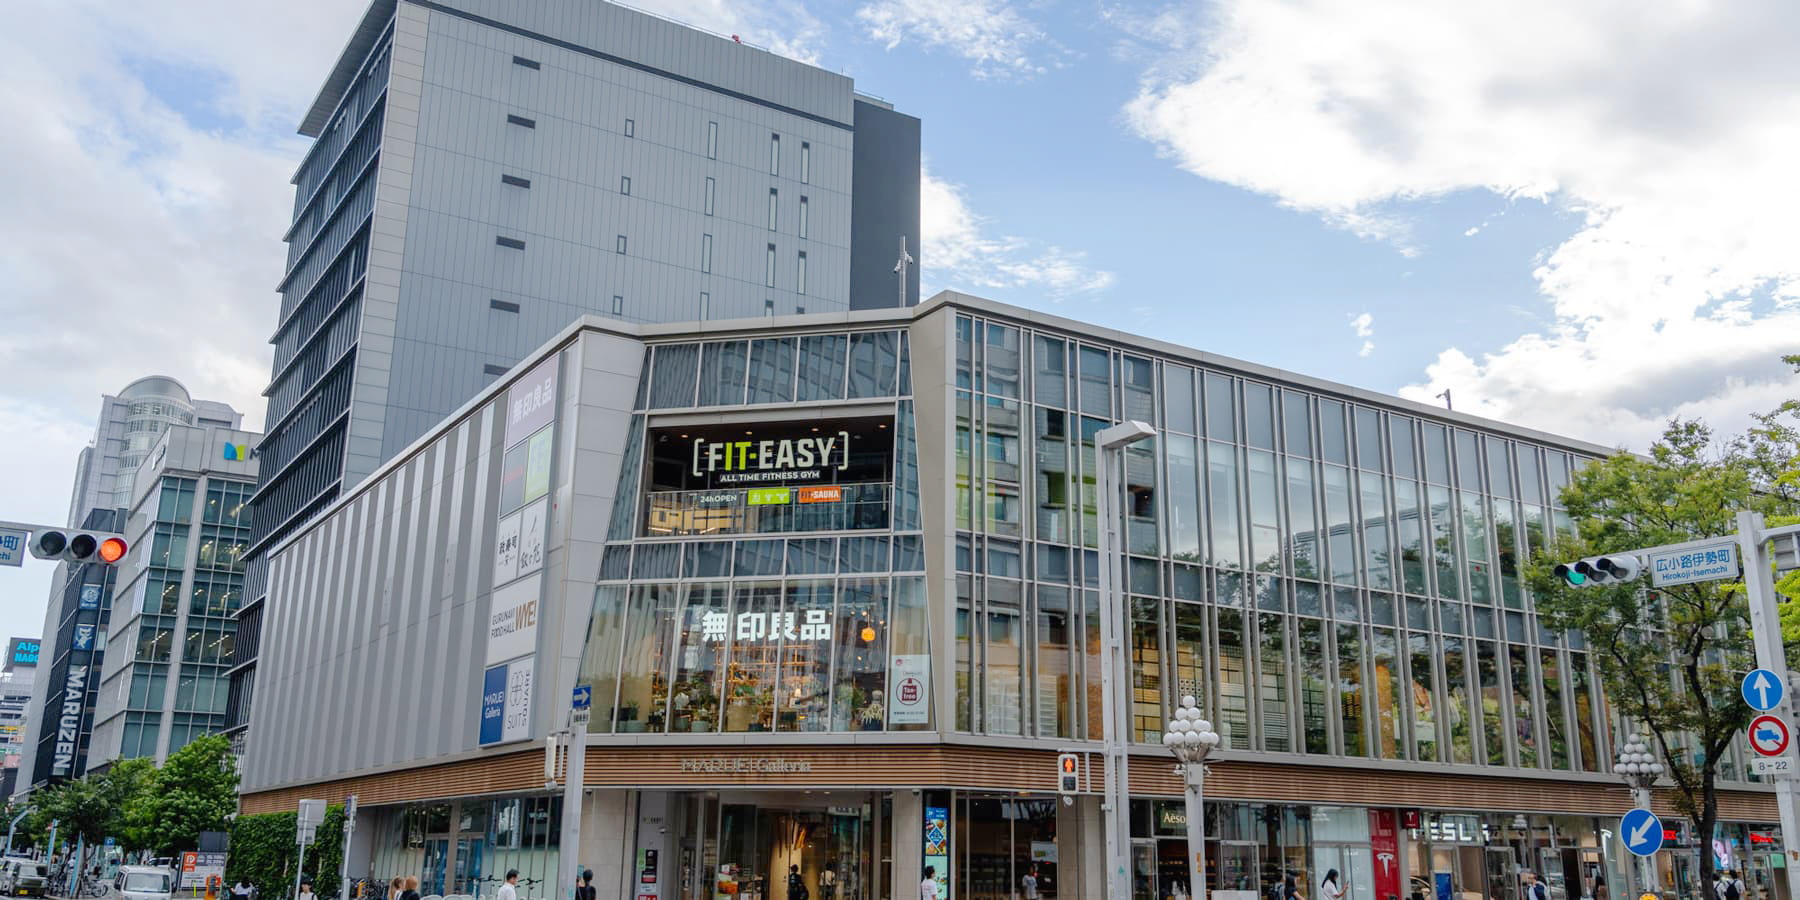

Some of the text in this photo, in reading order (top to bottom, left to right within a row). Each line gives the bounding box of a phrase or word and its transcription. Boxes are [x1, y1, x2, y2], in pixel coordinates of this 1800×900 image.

[512, 377, 553, 424] 無印良品
[720, 471, 820, 482] ALL TIME FITNESS GYM
[1656, 549, 1730, 572] 広小路伊勢町
[1662, 566, 1729, 581] Hirokoji-Isemachi
[515, 600, 537, 632] WYE!
[702, 610, 831, 642] 無印良品
[53, 669, 85, 771] MARUZEN
